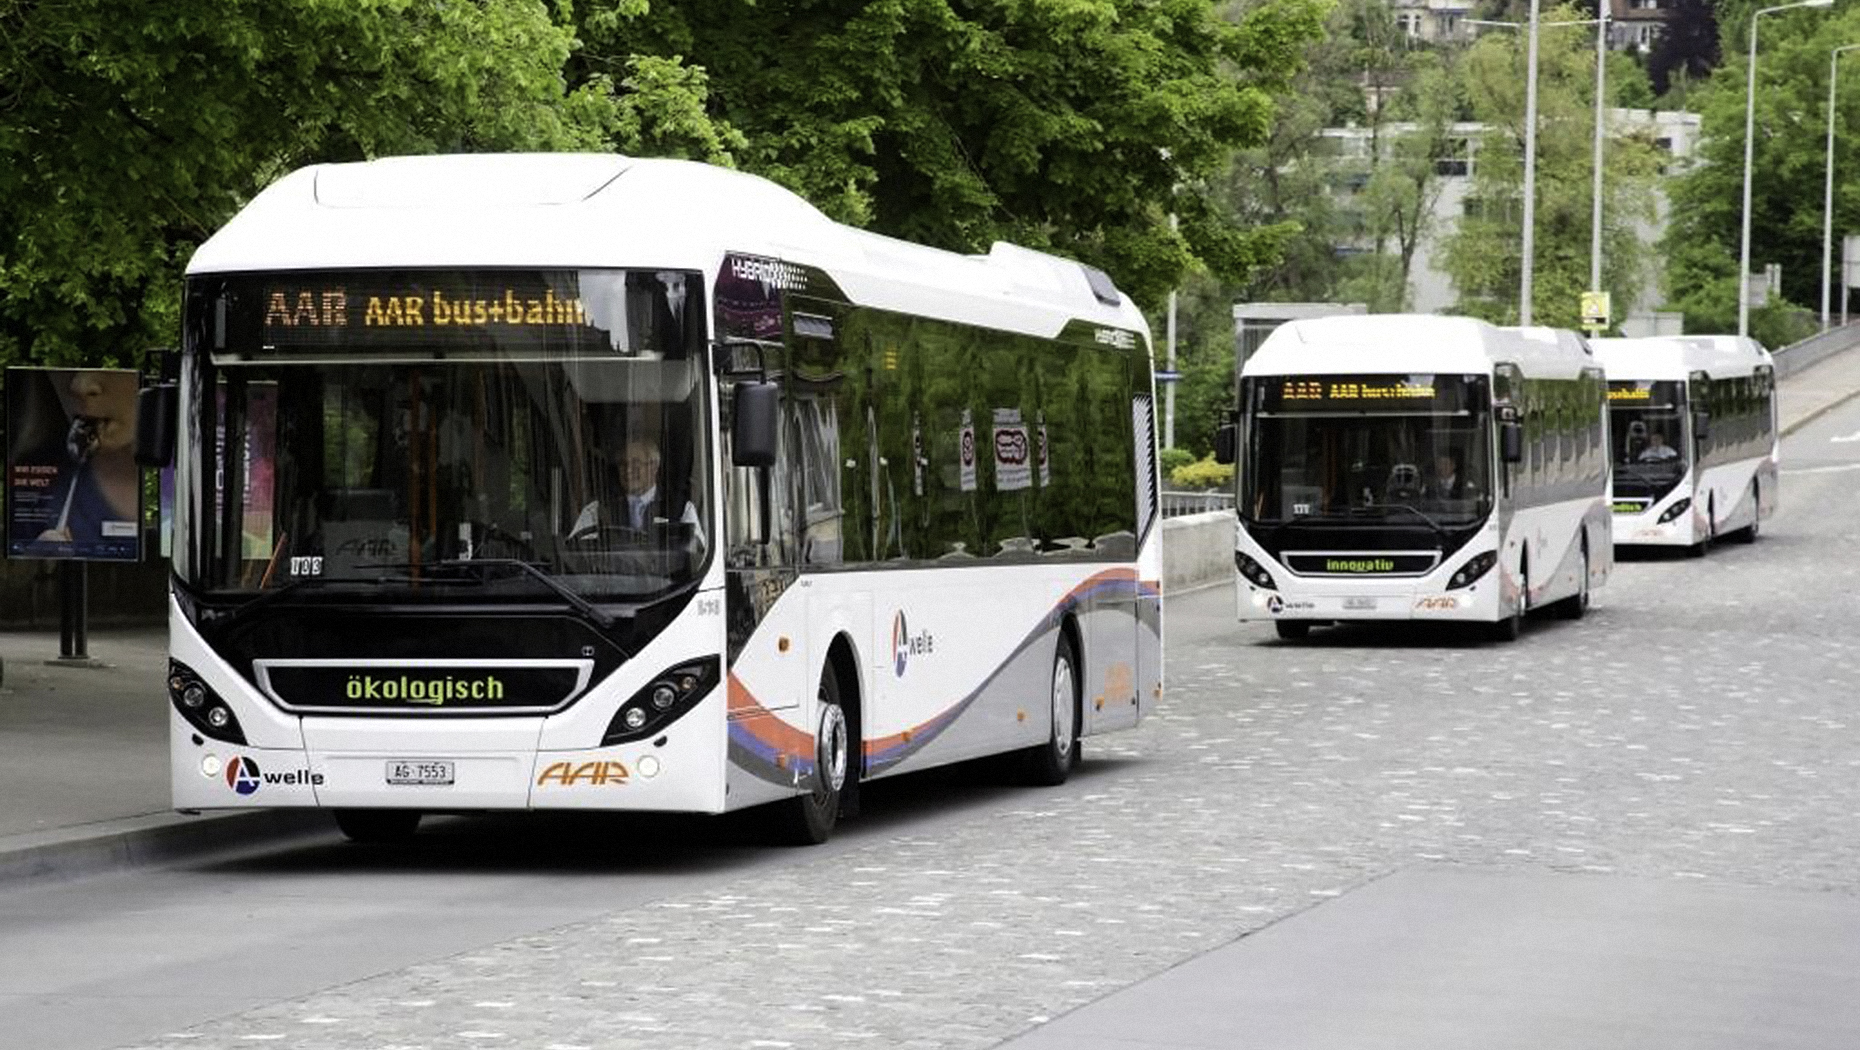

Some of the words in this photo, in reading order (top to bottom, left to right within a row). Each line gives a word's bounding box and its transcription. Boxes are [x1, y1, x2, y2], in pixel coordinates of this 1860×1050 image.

[264, 291, 347, 327] AAR
[365, 296, 424, 325] AAR
[434, 290, 587, 325] bus+bahn
[346, 675, 505, 706] ökologisch
[264, 771, 324, 786] welle
[417, 765, 447, 778] 7553
[538, 761, 629, 785] AAR
